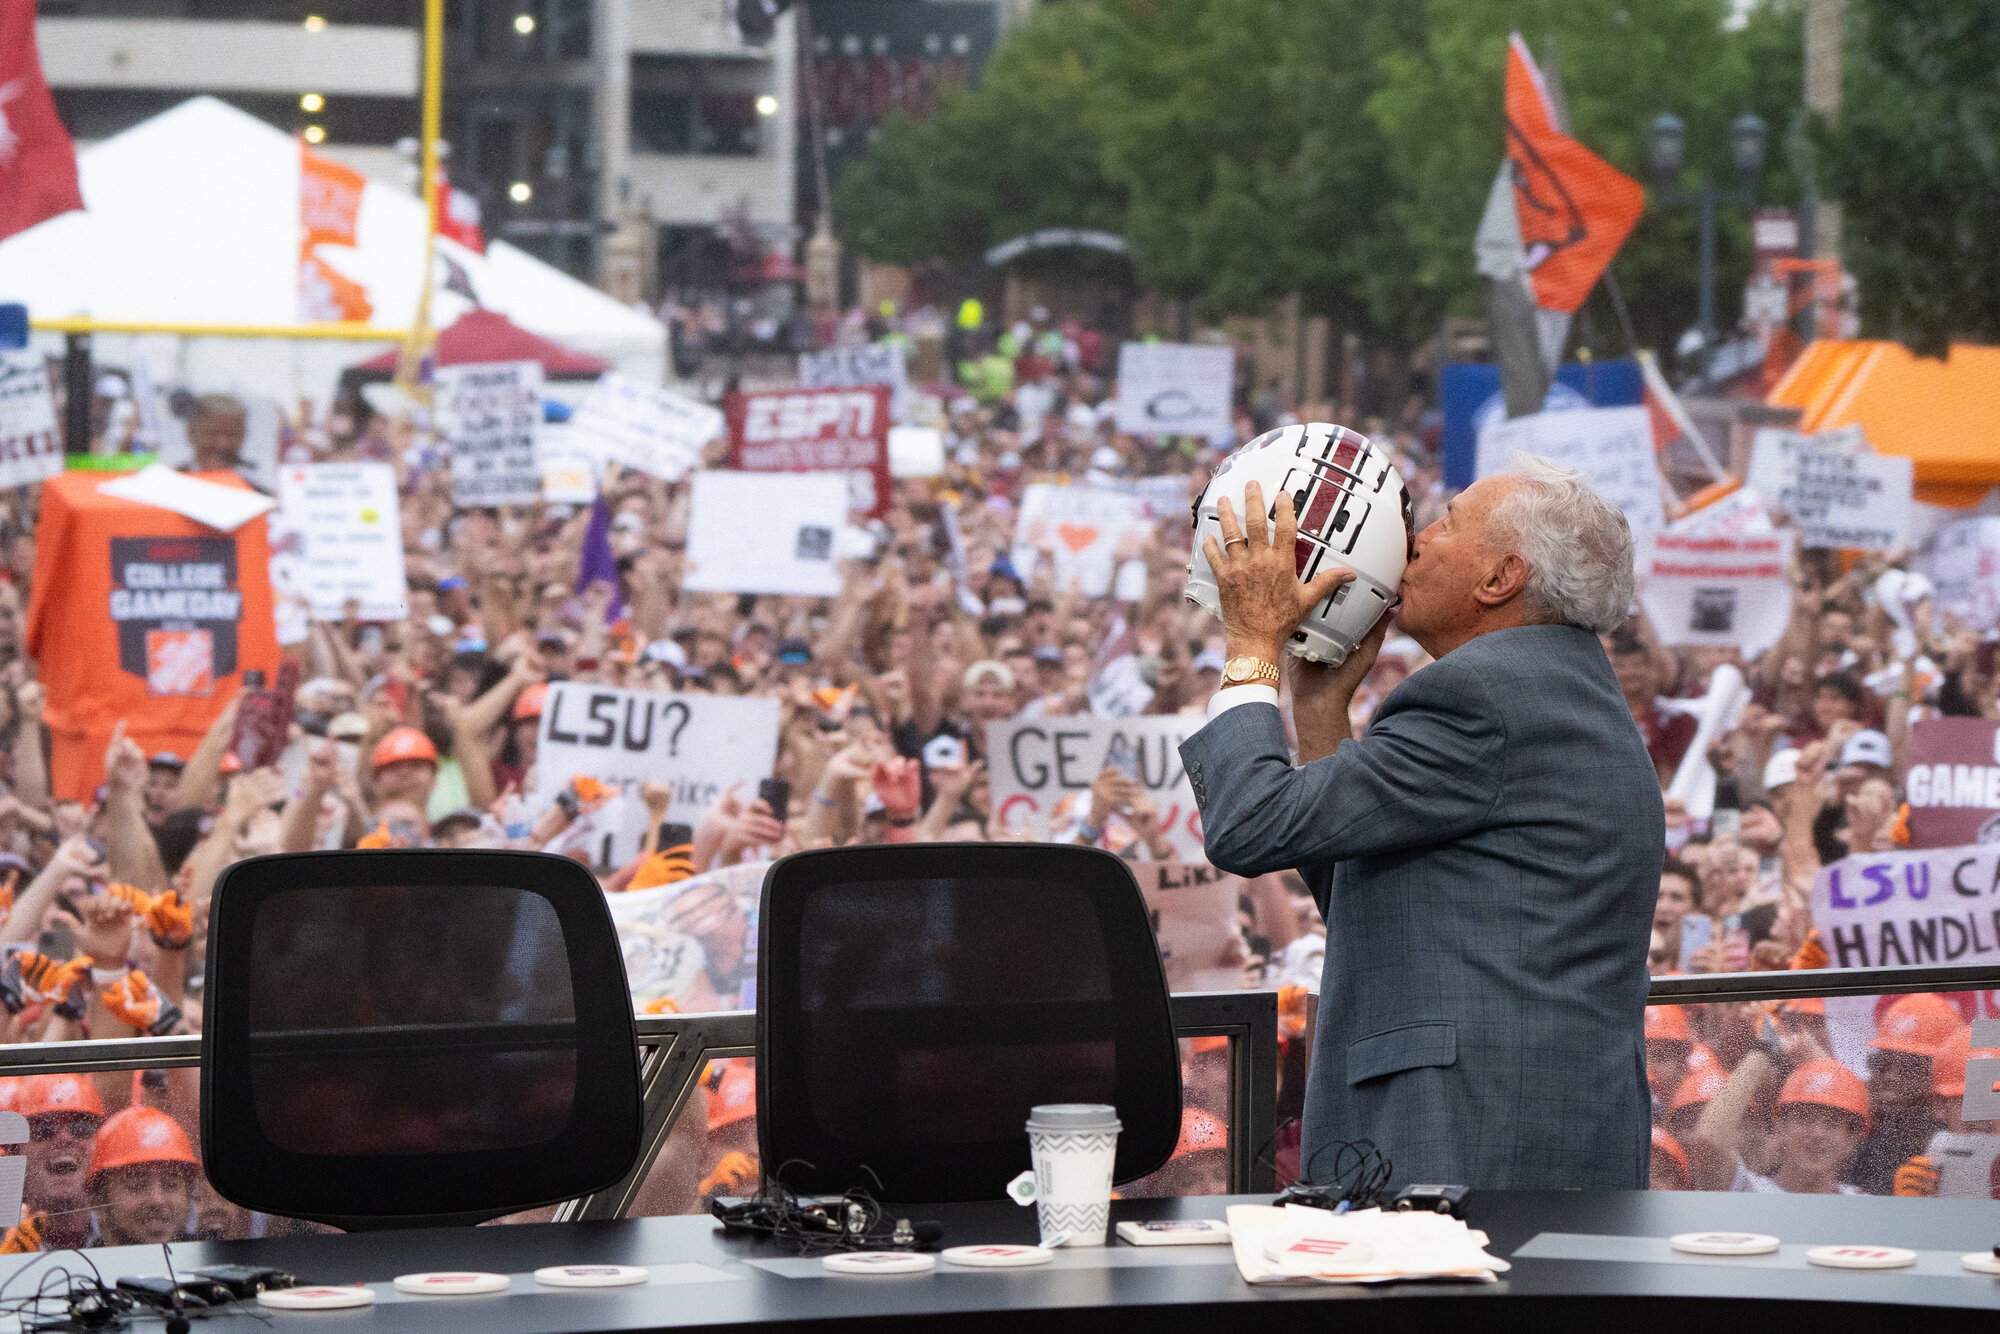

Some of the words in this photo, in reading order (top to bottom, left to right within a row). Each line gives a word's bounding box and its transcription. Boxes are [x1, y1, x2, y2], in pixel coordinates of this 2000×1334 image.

[744, 393, 876, 441] ESPN
[124, 562, 226, 588] COLLEGE
[109, 590, 242, 620] GAMEDAY
[548, 690, 691, 756] LSU?
[1829, 861, 1930, 909] LSU
